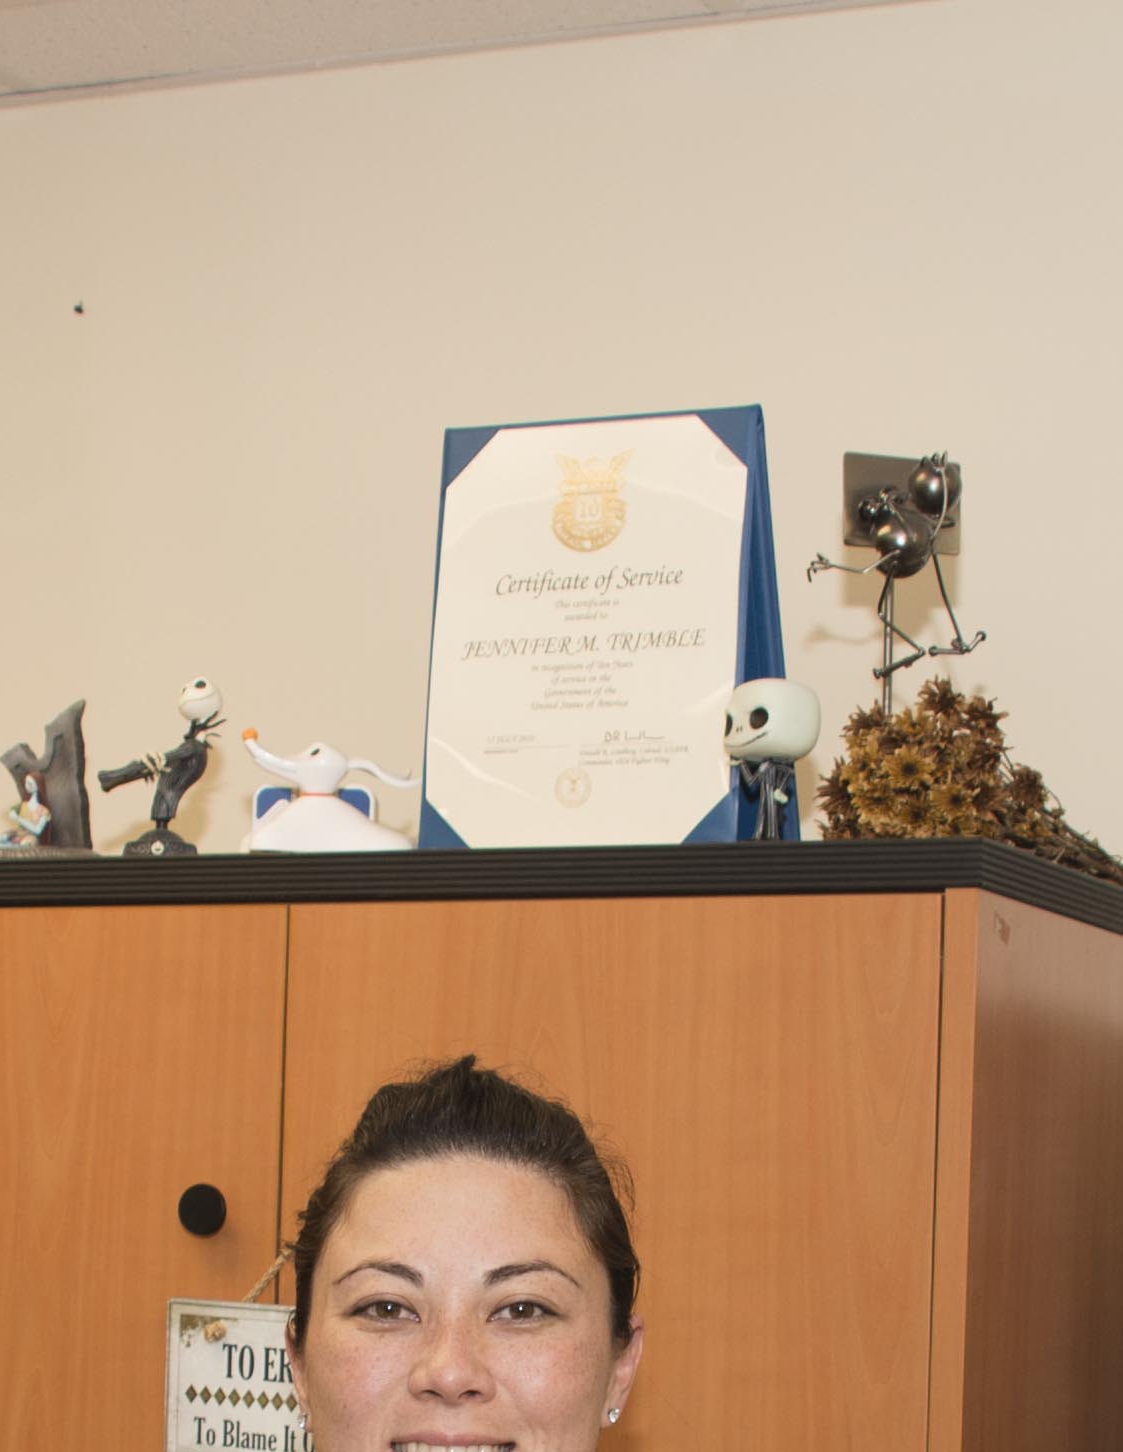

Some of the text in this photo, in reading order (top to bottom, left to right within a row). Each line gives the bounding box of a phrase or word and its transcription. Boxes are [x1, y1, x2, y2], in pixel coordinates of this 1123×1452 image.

[495, 564, 685, 599] Certificate of Service
[461, 627, 707, 661] JENNIFER M. TRIMBLE
[223, 1343, 255, 1380] TO
[193, 1416, 215, 1446] To
[223, 1419, 277, 1451] Blame
